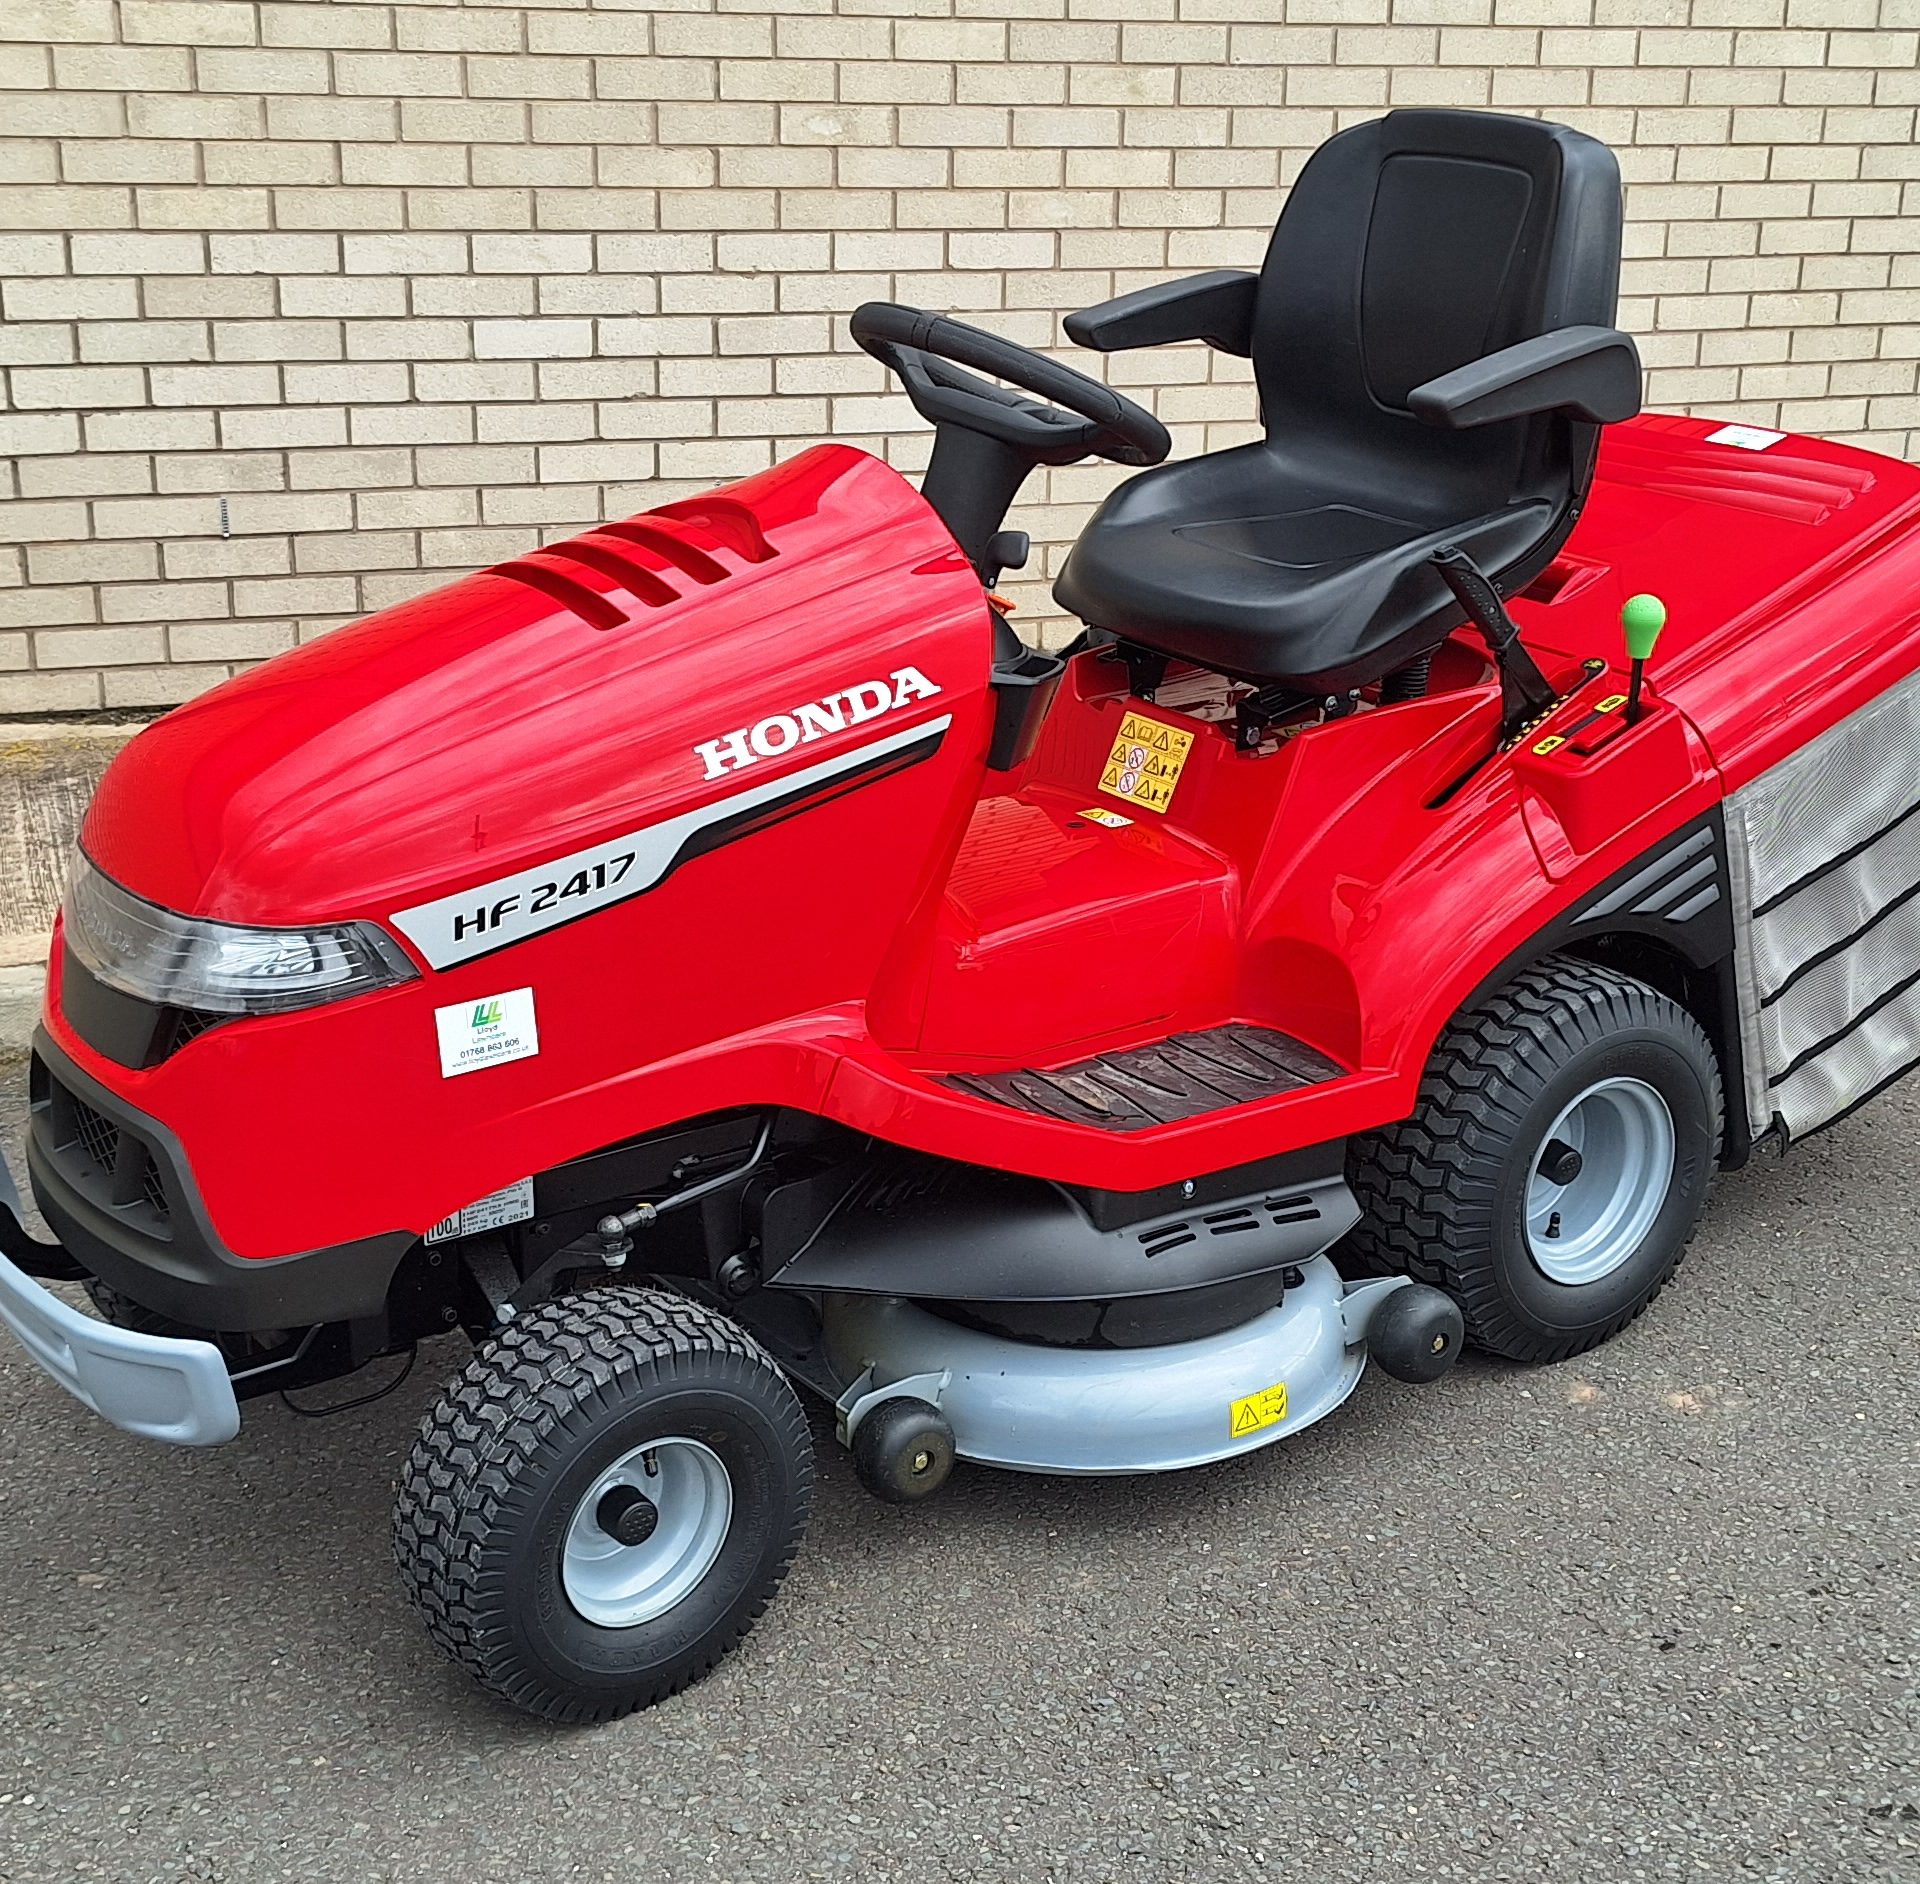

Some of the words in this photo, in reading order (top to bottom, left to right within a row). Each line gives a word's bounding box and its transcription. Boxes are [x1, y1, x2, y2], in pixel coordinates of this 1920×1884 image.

[694, 666, 942, 781] HONDA
[453, 894, 521, 942] HF
[530, 851, 638, 917] 2417
[477, 1024, 498, 1035] Lloyd
[460, 1046, 485, 1059] 01768
[508, 1210, 529, 1222] 2021
